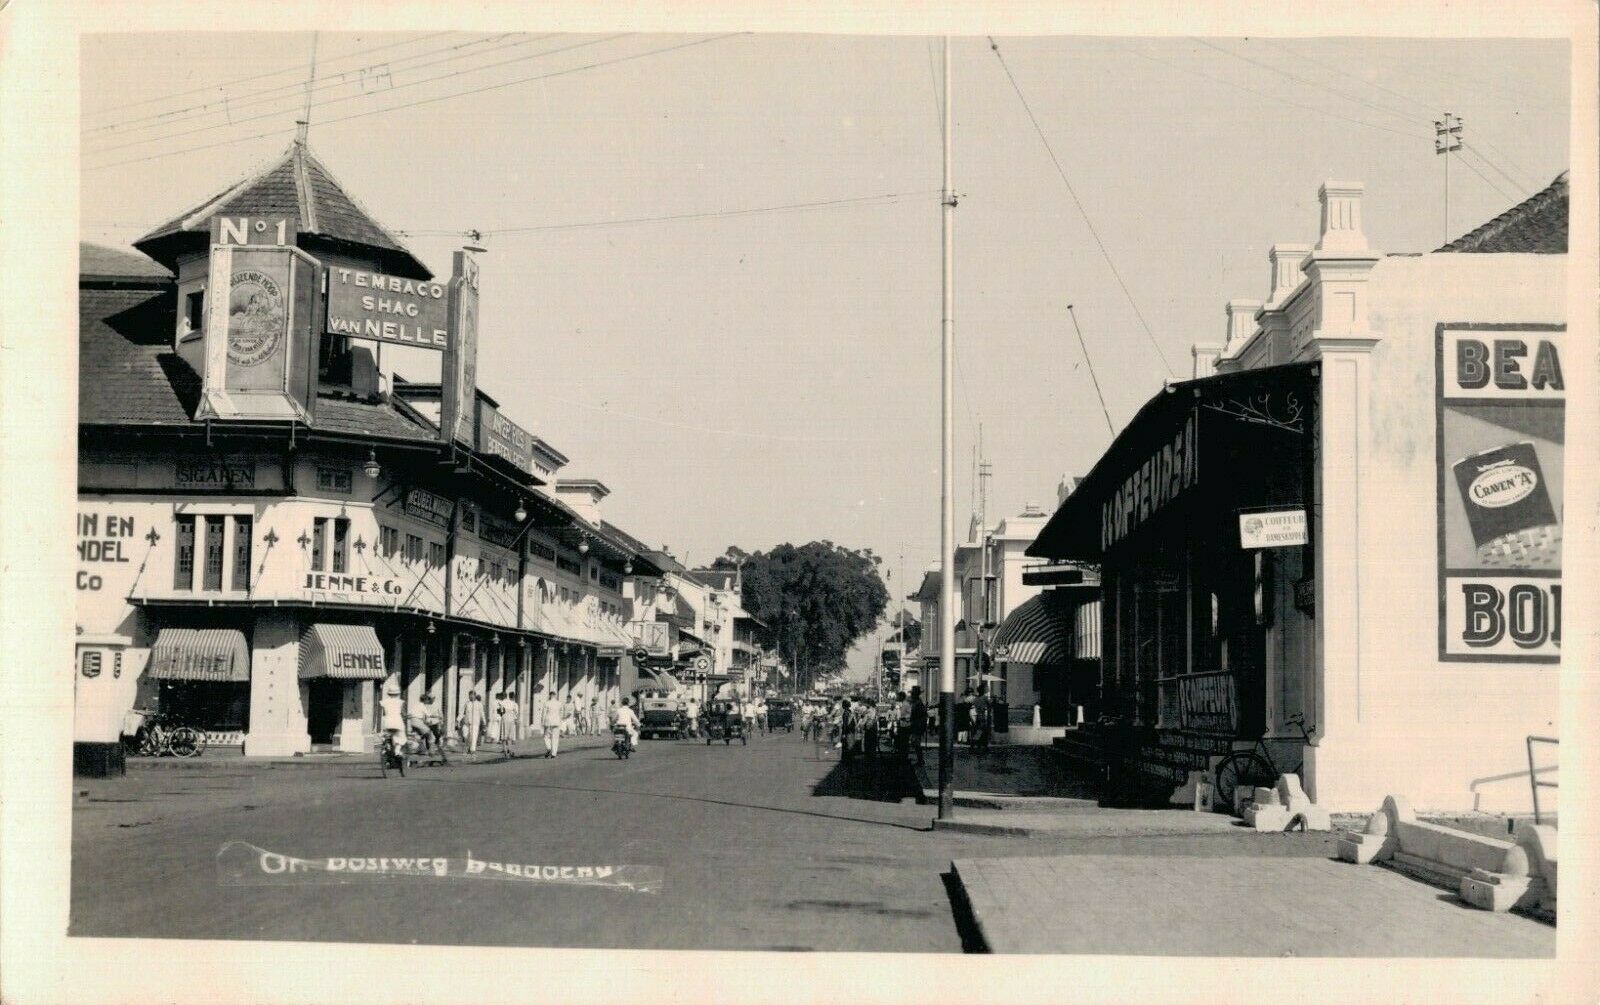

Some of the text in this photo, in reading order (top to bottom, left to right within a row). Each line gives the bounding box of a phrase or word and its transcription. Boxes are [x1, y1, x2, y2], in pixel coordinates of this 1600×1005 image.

[275, 219, 286, 246] 1
[338, 268, 443, 299] TEMBACO
[361, 295, 419, 317] SHAG
[329, 317, 448, 347] VAN NELLE
[1456, 339, 1566, 391] BEA
[106, 515, 134, 537] EN
[303, 573, 367, 592] JENNE
[371, 582, 379, 593] &
[333, 653, 382, 669] JENNE
